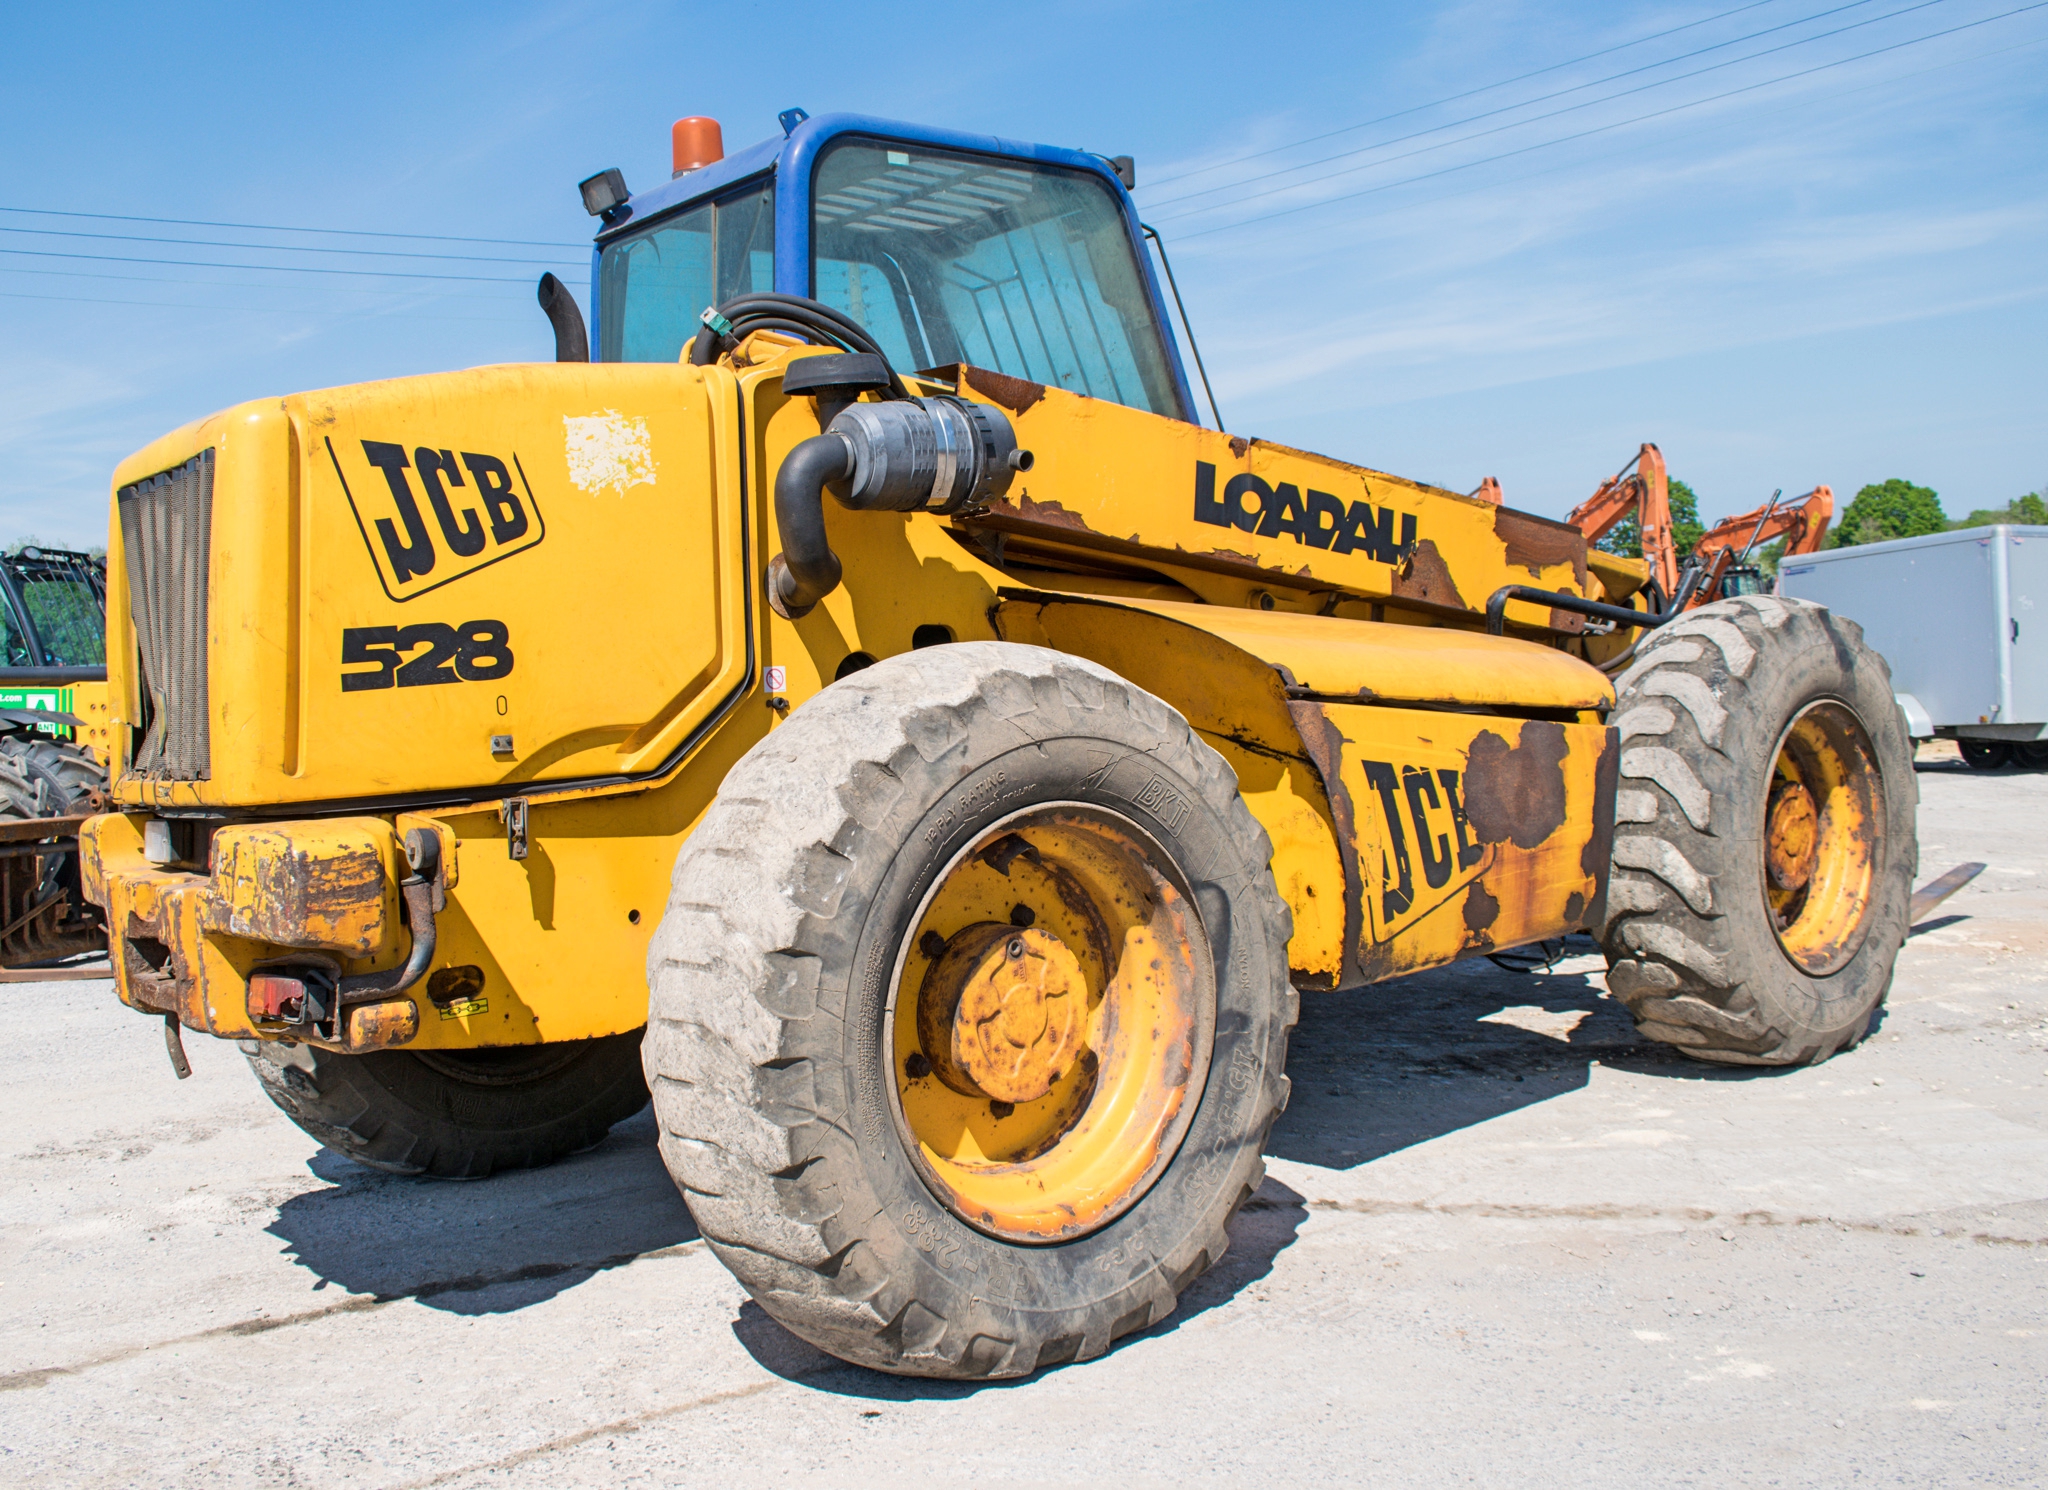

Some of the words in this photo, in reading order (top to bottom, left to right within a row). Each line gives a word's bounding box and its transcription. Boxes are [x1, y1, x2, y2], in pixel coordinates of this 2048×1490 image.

[360, 439, 529, 585] JCB
[1194, 460, 1418, 565] LOADALL
[341, 619, 514, 692] 528
[37, 723, 54, 731] ANT
[935, 803, 957, 832] PLY
[958, 770, 1007, 812] RATING
[1137, 777, 1189, 830] BKT
[1238, 946, 1250, 990] NYLON
